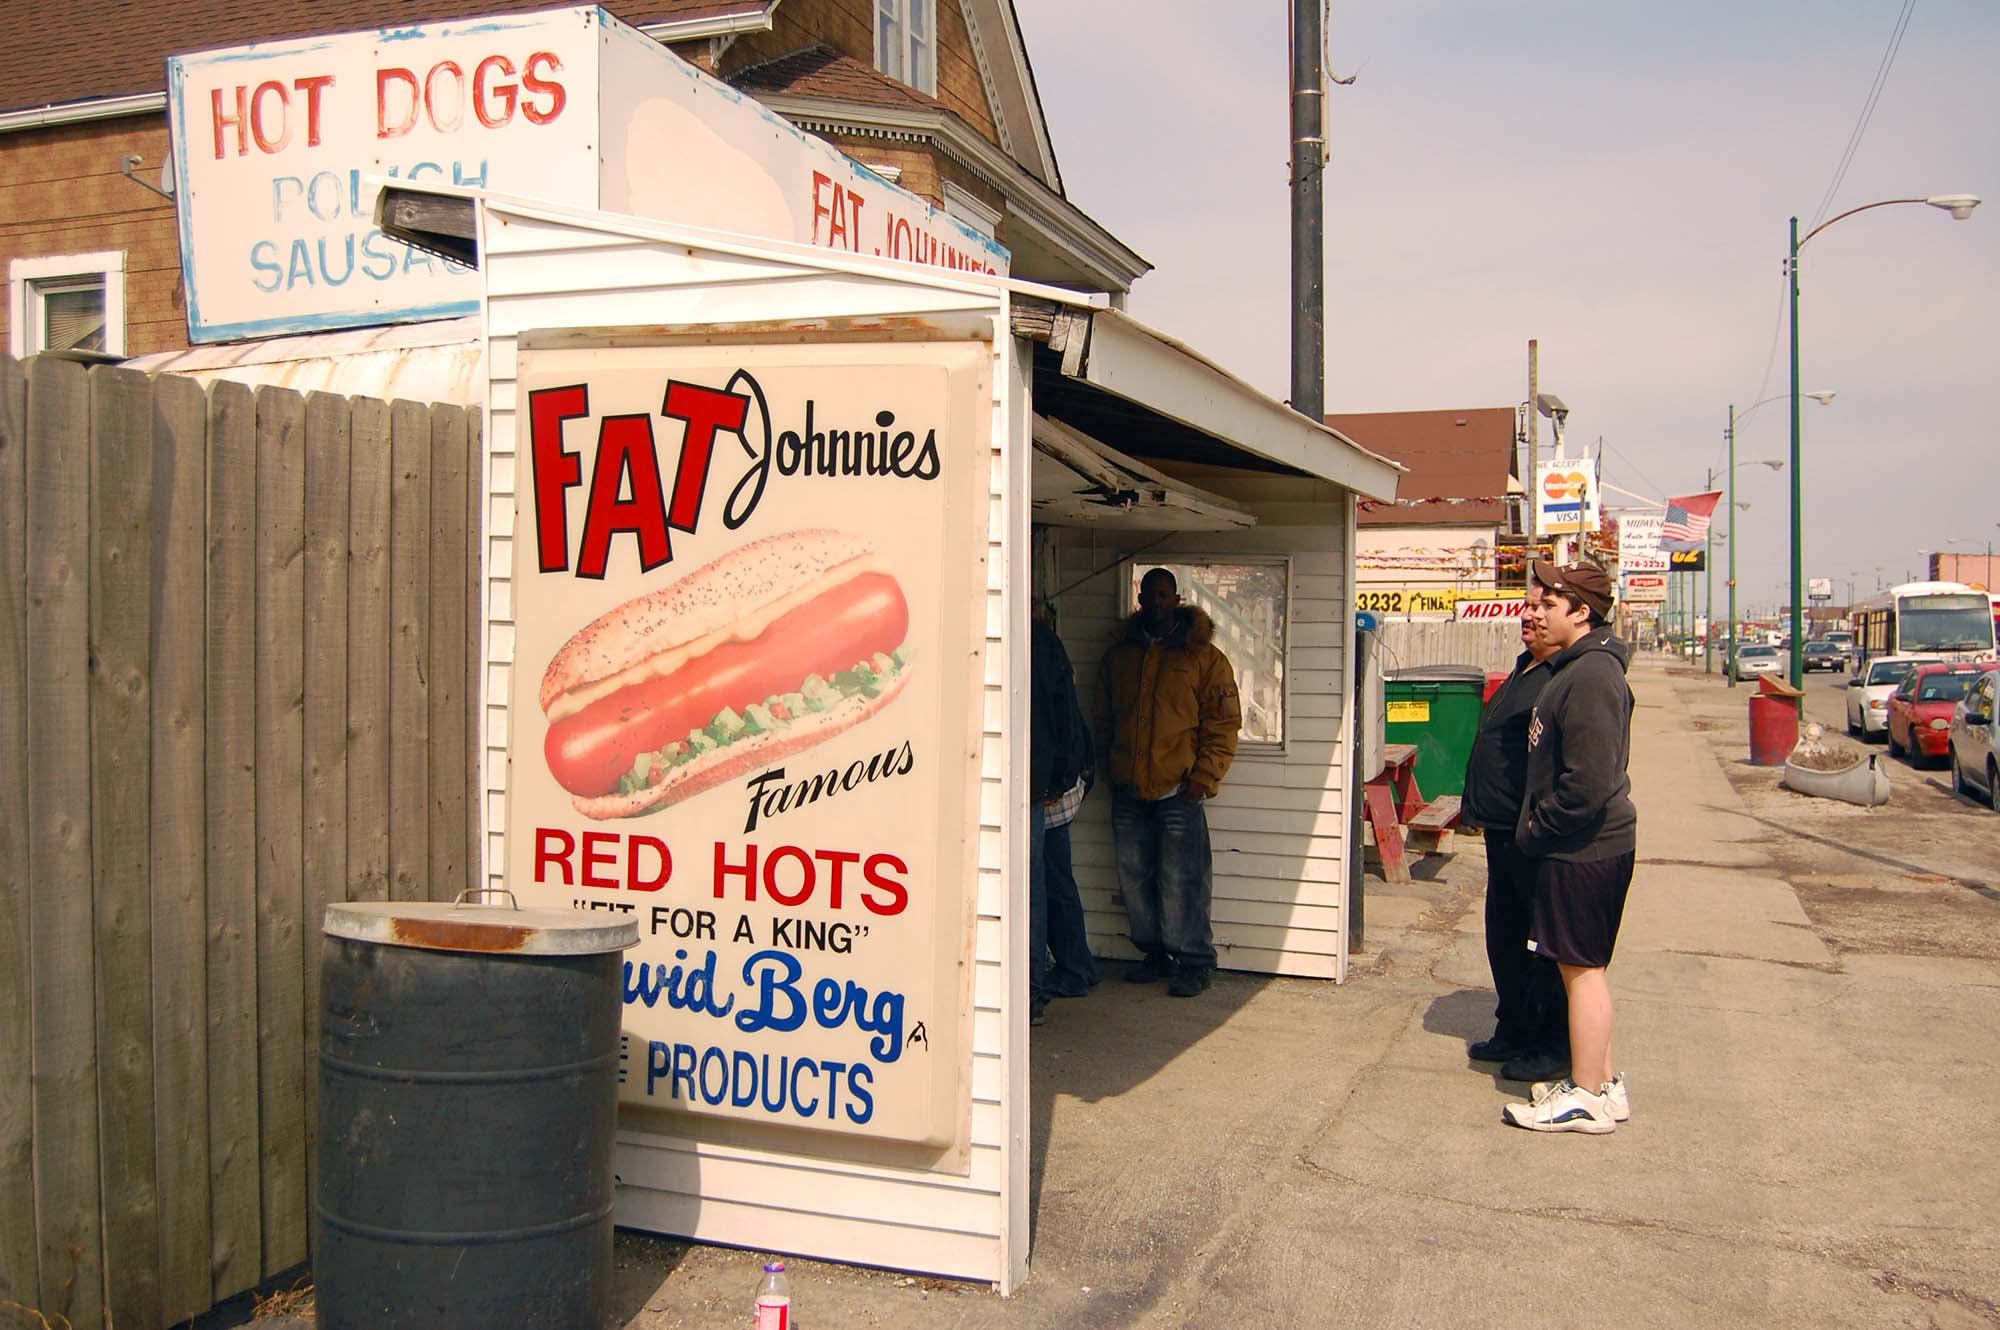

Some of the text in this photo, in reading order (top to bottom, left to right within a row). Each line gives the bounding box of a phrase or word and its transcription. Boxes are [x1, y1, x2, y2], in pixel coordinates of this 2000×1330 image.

[211, 51, 566, 160] HOT DOGS
[273, 160, 488, 224] POLH
[812, 170, 864, 252] FAT
[250, 228, 471, 292] SAUSA
[528, 368, 941, 580] FAT Johnnies
[1553, 460, 1580, 468] ACCEPT
[1557, 512, 1579, 522] VISA
[1626, 519, 1664, 528] MIDWES
[1358, 593, 1402, 612] 3232
[1462, 602, 1527, 618] MIDW
[743, 740, 914, 834] Famous
[534, 827, 909, 916] RED HOTS
[651, 906, 716, 940] FOR
[733, 914, 755, 944] A
[623, 949, 735, 1018] vid
[734, 949, 905, 1063] Berg
[647, 1040, 875, 1125] PRODUCTS
